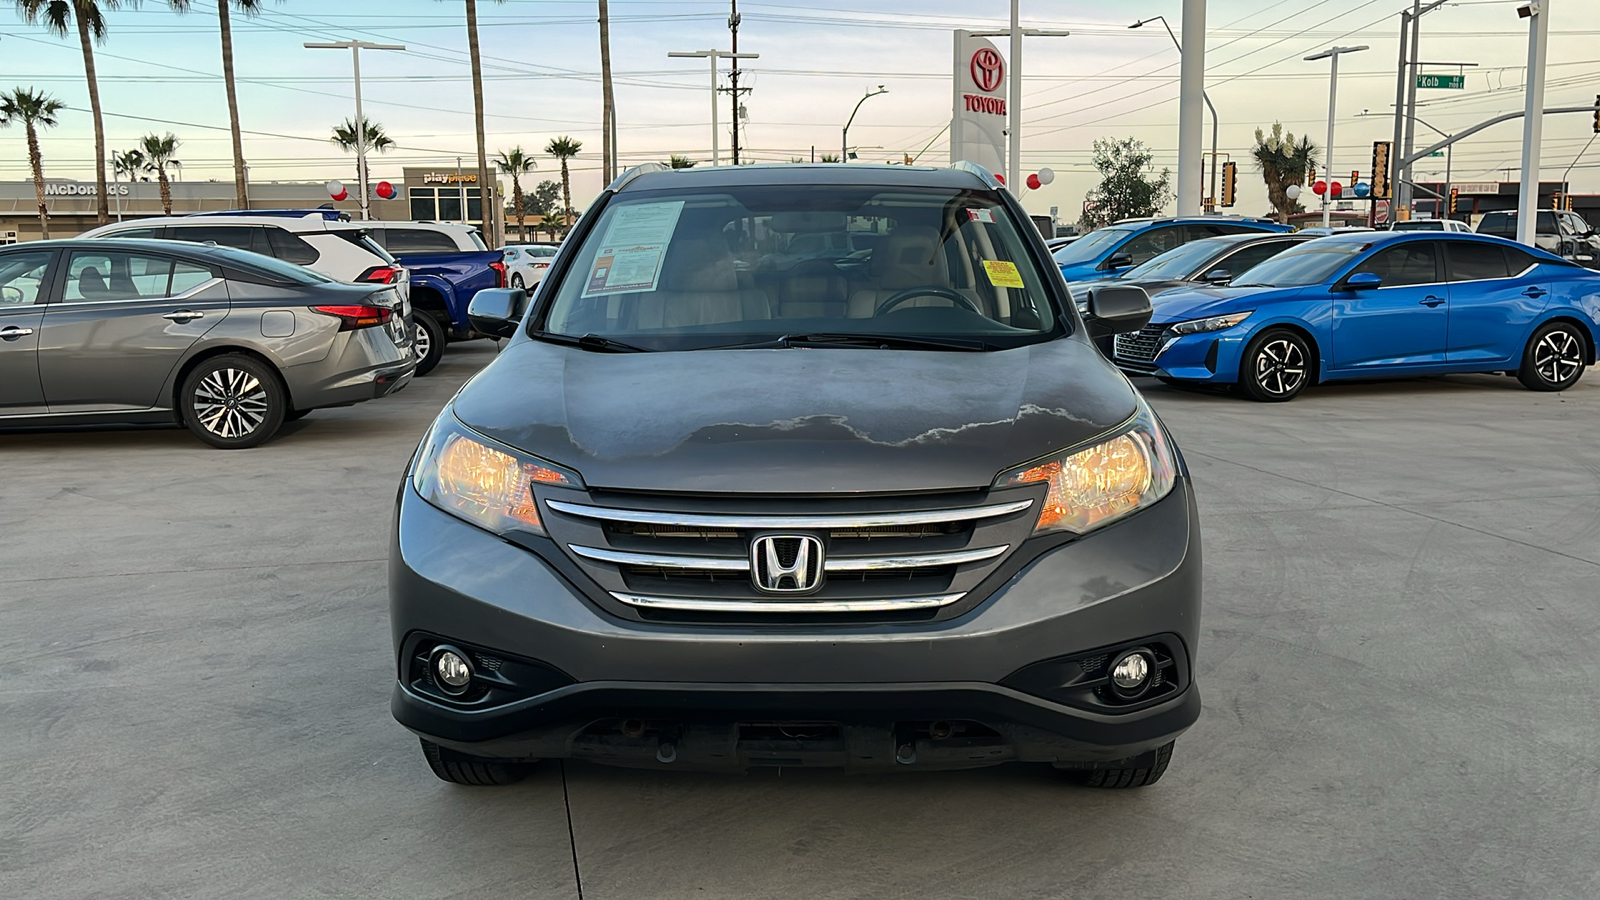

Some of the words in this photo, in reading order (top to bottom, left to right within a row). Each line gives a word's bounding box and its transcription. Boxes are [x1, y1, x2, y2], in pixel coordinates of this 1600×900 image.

[1421, 76, 1439, 87] Kolb
[963, 94, 1007, 116] TOYOTA
[45, 184, 129, 195] McDonld's
